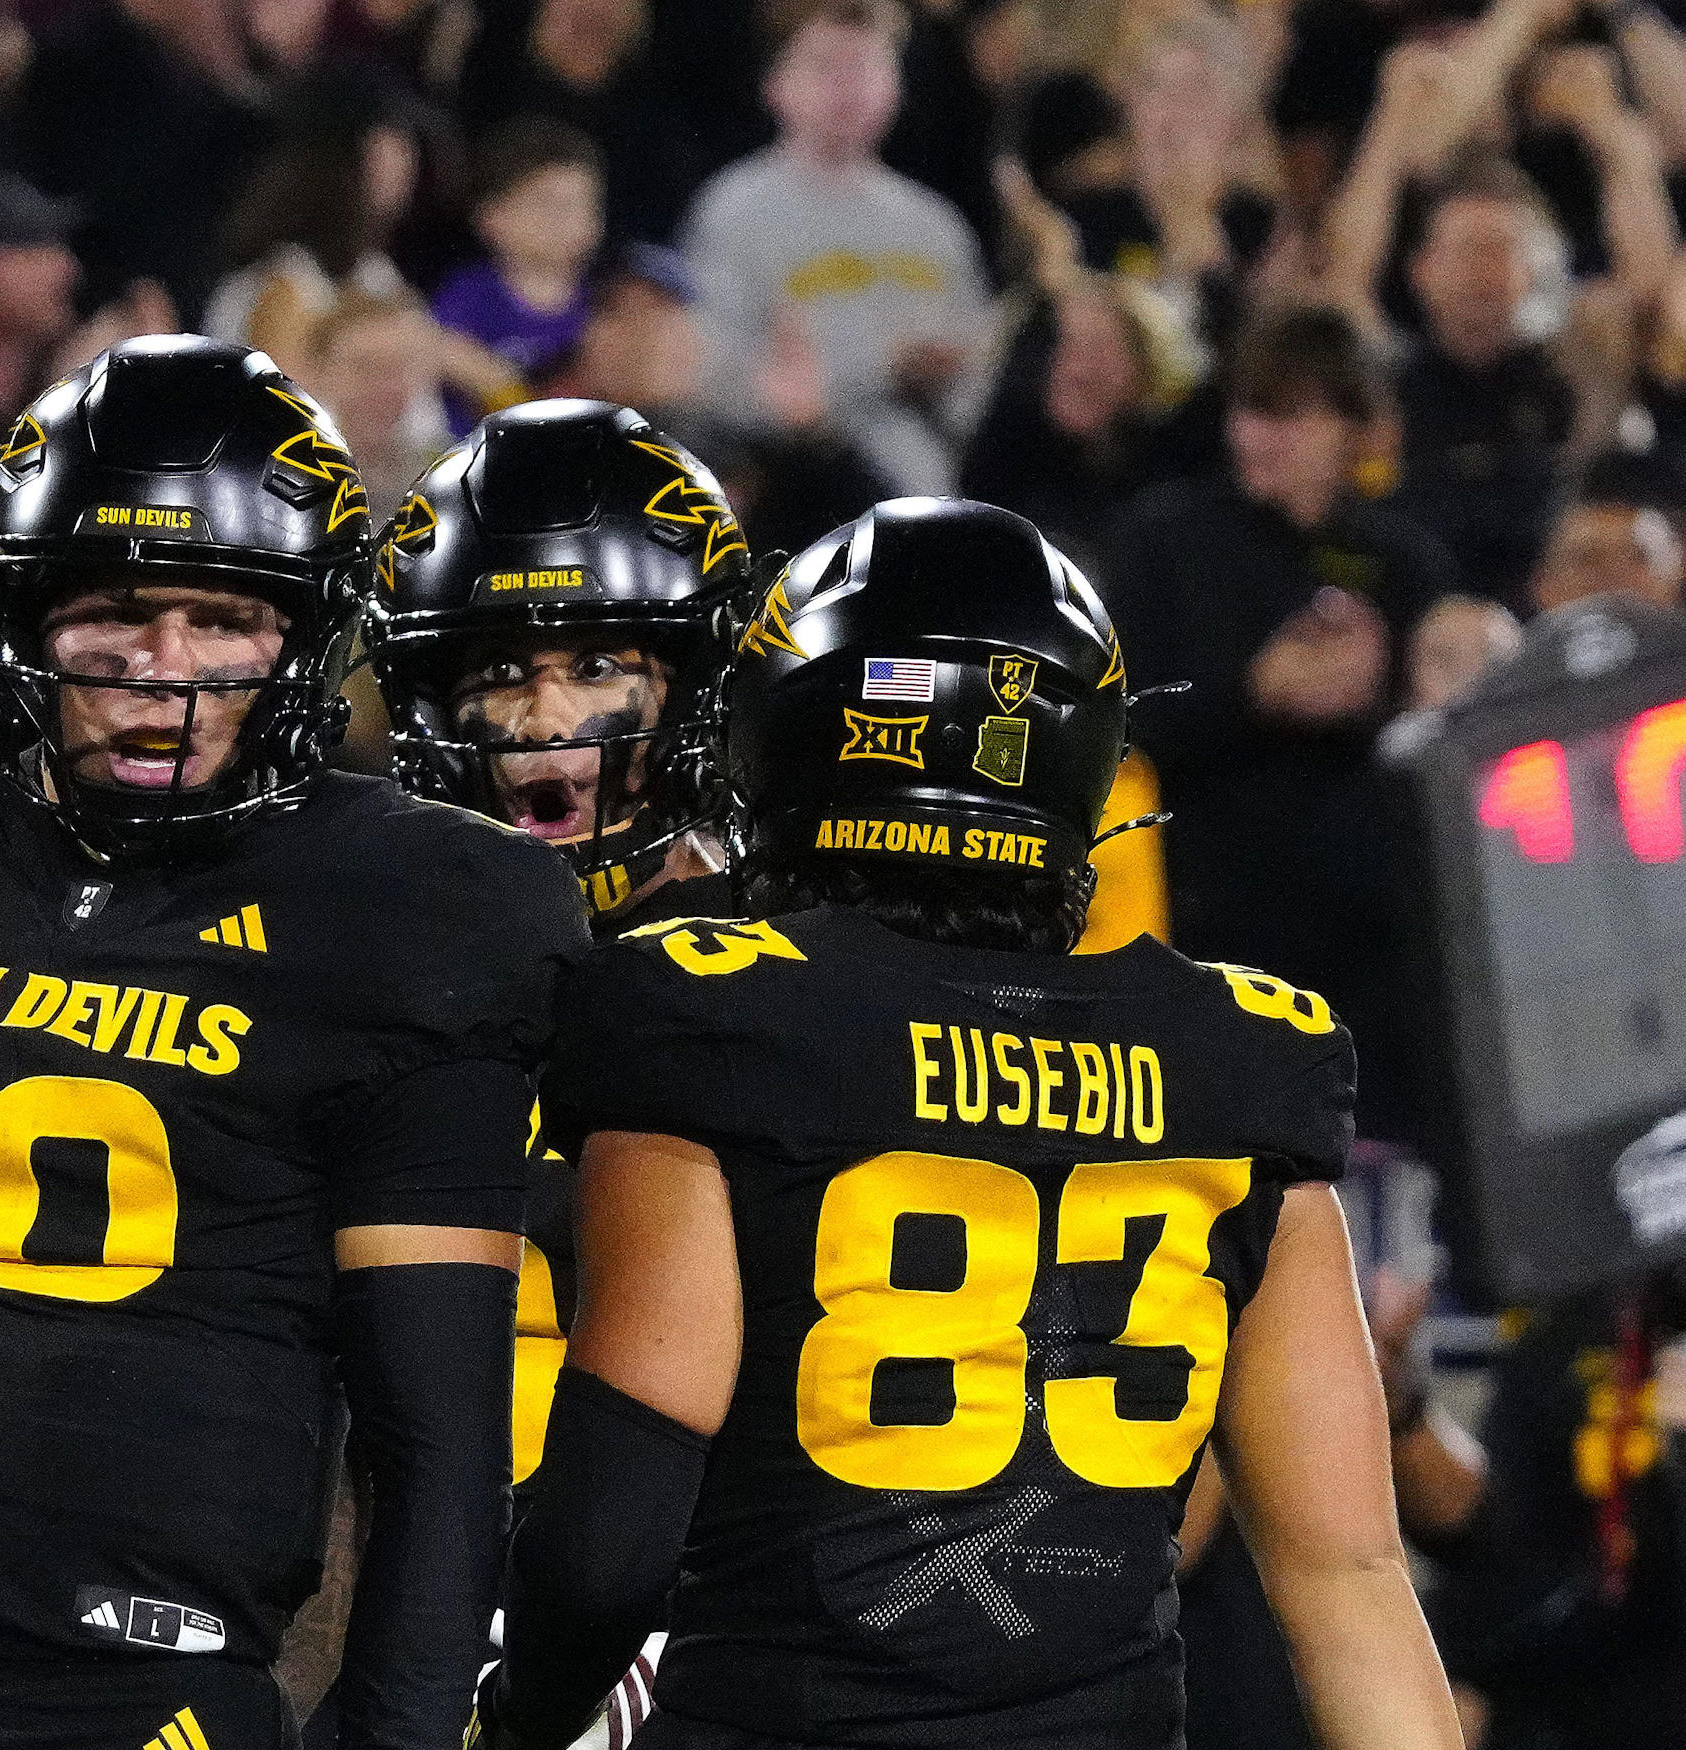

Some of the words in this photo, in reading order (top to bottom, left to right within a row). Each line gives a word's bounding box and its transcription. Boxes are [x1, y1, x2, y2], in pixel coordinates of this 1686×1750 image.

[96, 507, 131, 524] SUN
[135, 508, 192, 528] DEVILS
[490, 573, 524, 591] SUN
[528, 570, 583, 588] DEVILS
[1002, 661, 1023, 679] PT
[999, 682, 1020, 700] 42
[815, 819, 951, 856] ARIZONA
[961, 829, 1048, 869] STATE
[0, 972, 254, 1076] DEVILS
[908, 1021, 1164, 1144] EUSEBIO
[796, 1151, 1253, 1491] 83
